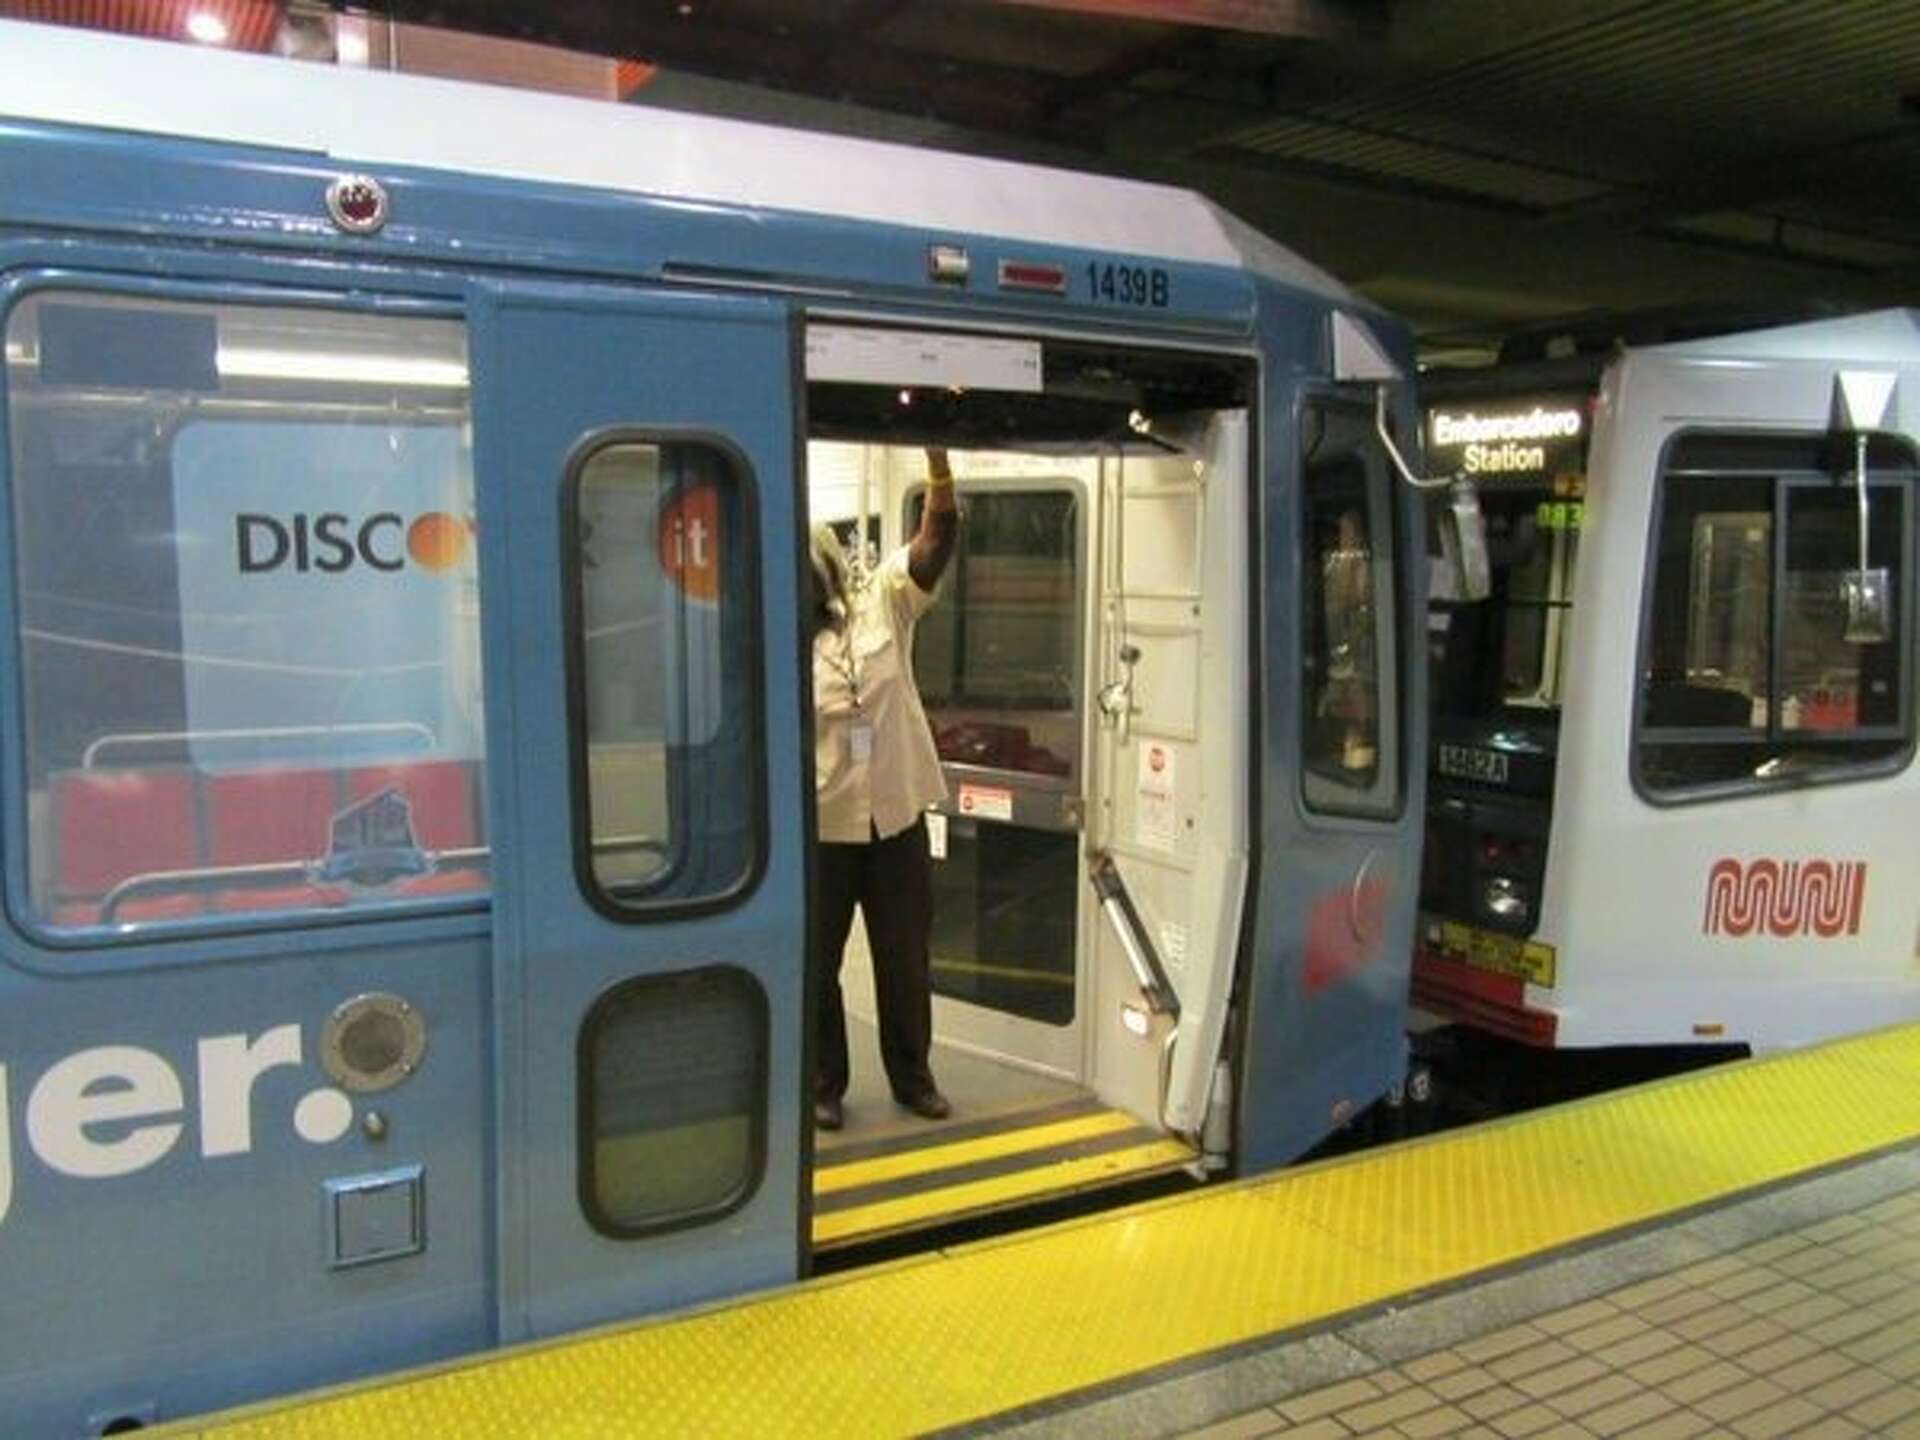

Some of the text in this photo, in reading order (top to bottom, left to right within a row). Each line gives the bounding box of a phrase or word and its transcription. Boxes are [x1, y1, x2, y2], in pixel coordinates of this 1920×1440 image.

[1088, 260, 1170, 308] 1439B
[1463, 443, 1545, 473] Station
[673, 517, 710, 569] it
[0, 1023, 354, 1226] er.
